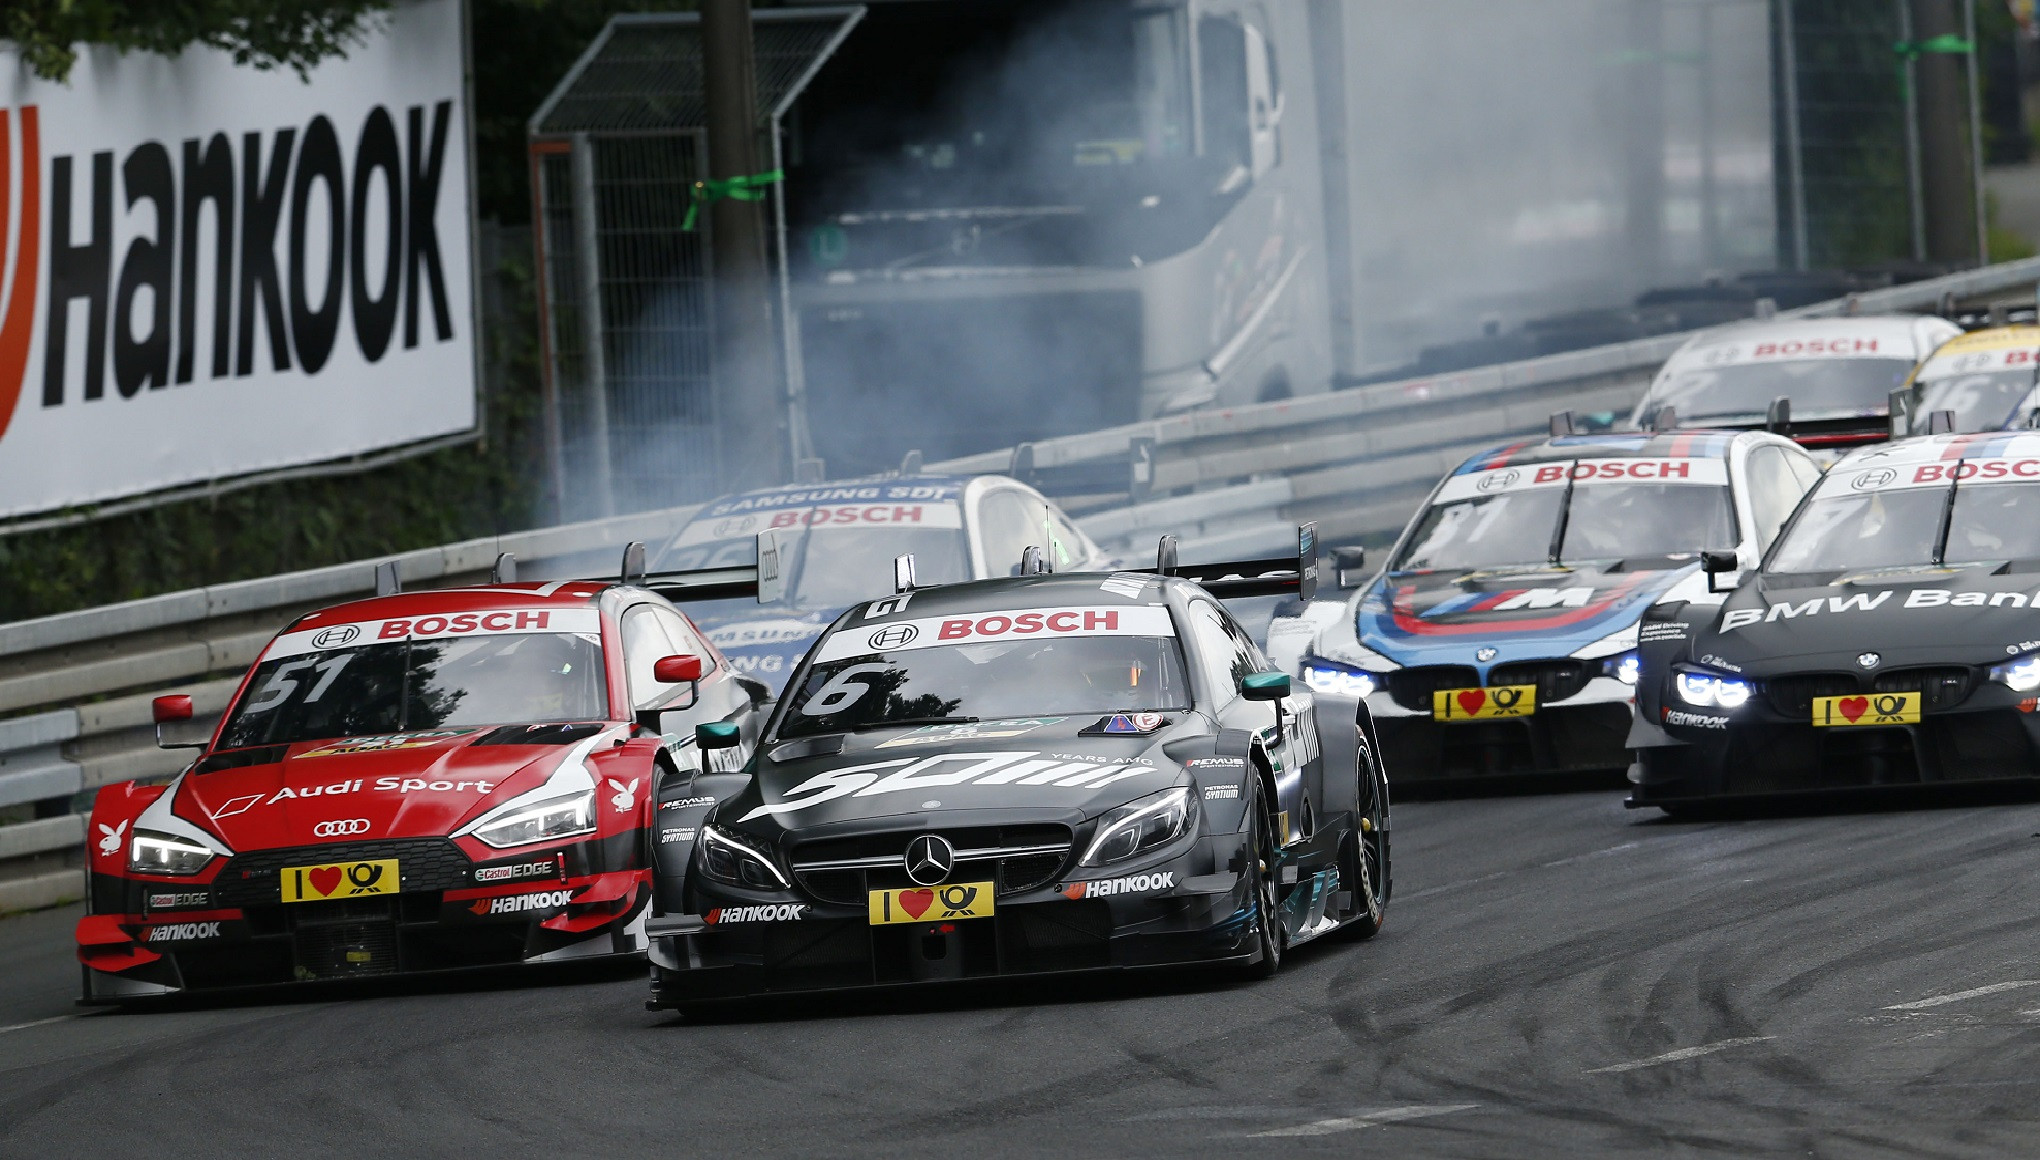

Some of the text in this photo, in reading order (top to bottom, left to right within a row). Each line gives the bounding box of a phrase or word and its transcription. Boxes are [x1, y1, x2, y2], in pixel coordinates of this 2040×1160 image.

[1754, 338, 1879, 356] BOSCH
[1534, 462, 1689, 484] BOSCH
[713, 486, 946, 515] SAMSUNG SDI
[770, 506, 922, 529] BOSCH
[1718, 590, 1893, 634] BMW
[377, 611, 550, 640] BOSCH
[937, 610, 1119, 640] BOSCH
[244, 652, 355, 714] 51
[802, 662, 890, 716] 6
[1052, 752, 1109, 764] YEARS
[1111, 754, 1154, 766] AMG
[1187, 758, 1245, 768] REMUS
[266, 777, 495, 805] Audi Sport
[659, 796, 716, 810] REMUS
[484, 868, 511, 880] Castrol
[512, 861, 554, 878] EDGE
[175, 892, 208, 906] EDGE
